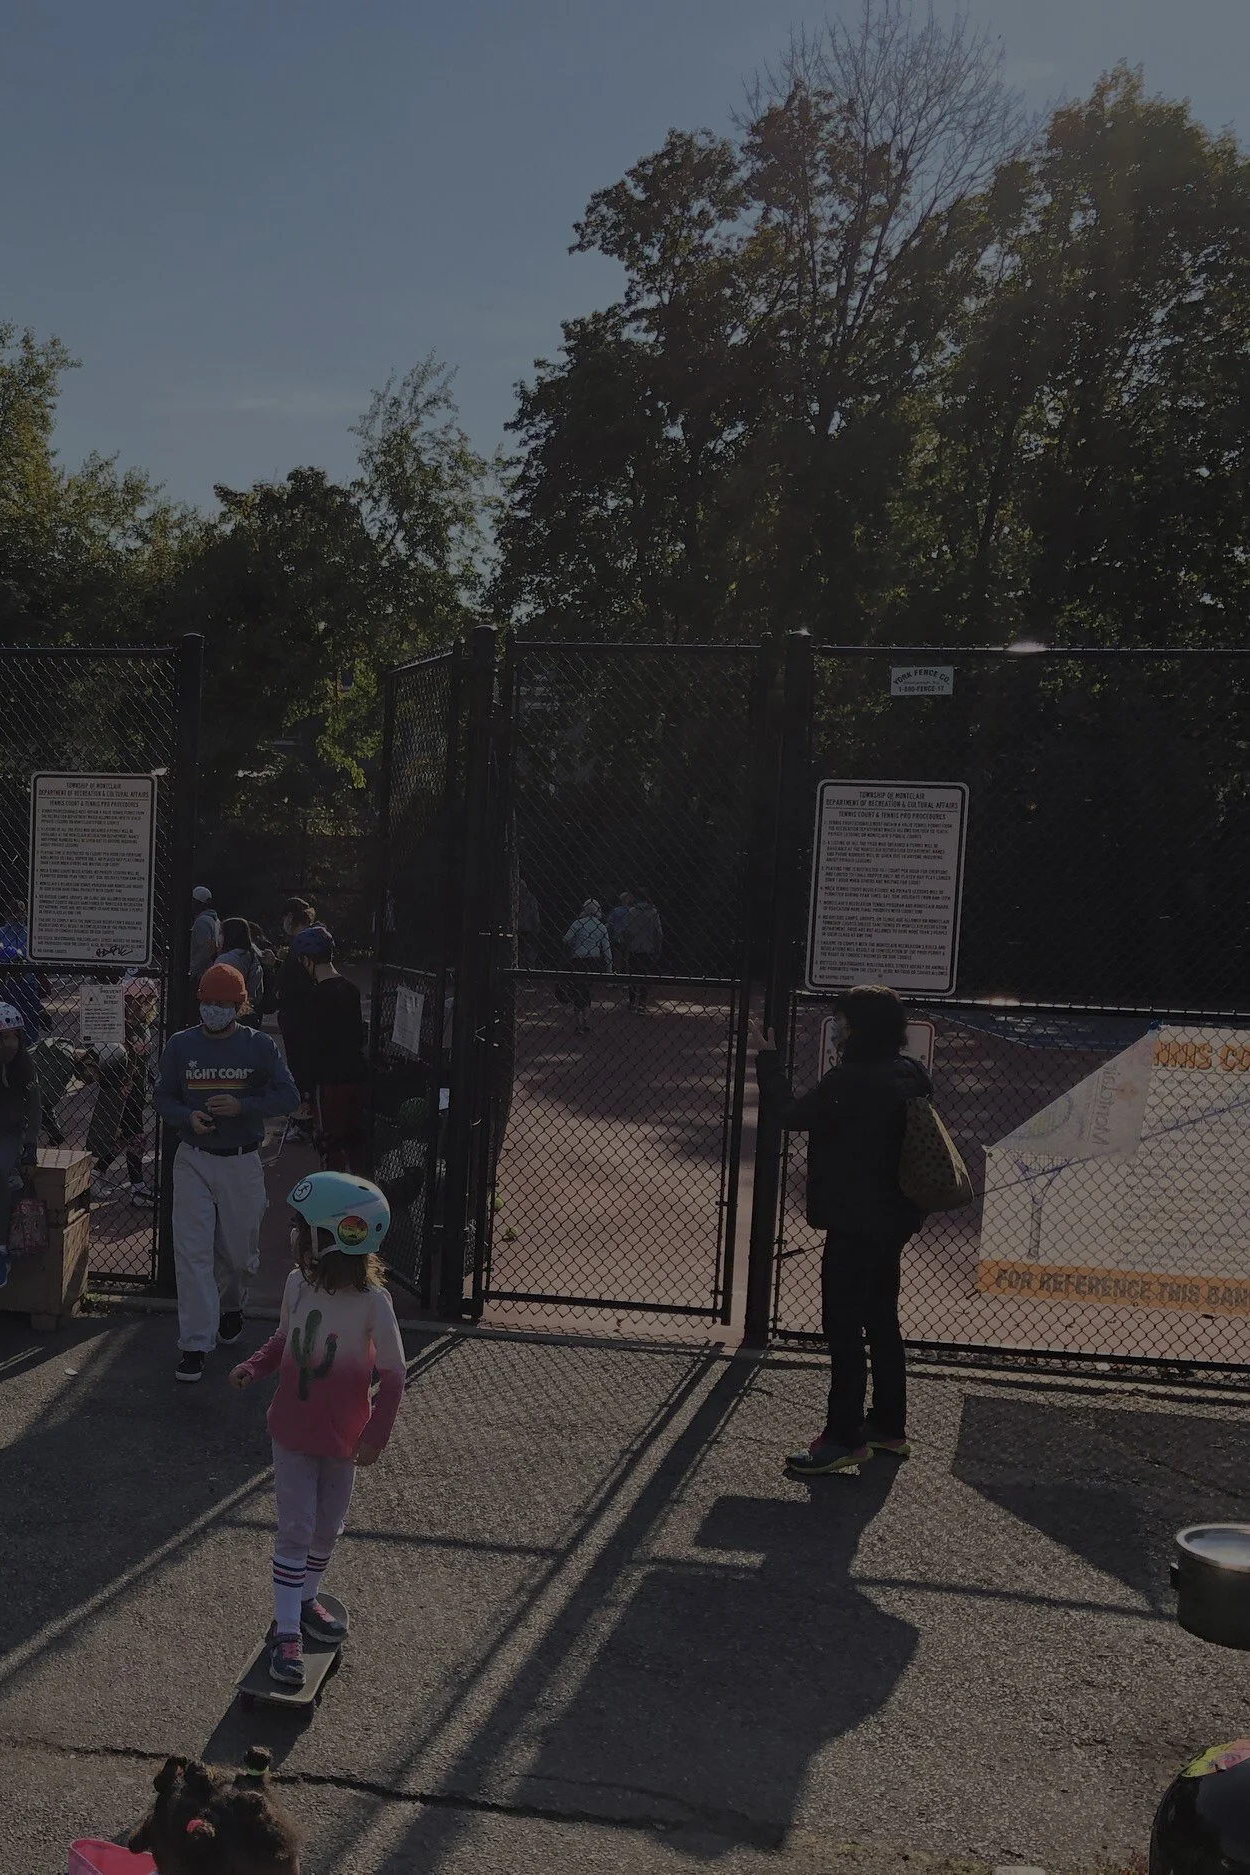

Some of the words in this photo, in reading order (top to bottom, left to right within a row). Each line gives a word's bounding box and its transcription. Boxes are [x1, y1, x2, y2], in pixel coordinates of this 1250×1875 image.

[893, 672, 913, 685] YORK
[914, 669, 939, 678] FENCE
[859, 791, 886, 799] TOWNSHIP
[895, 792, 925, 800] MONTCLAIR
[997, 1269, 1031, 1290] FOR
[1039, 1272, 1151, 1300] REFERENCE
[1159, 1281, 1201, 1303] THIS
